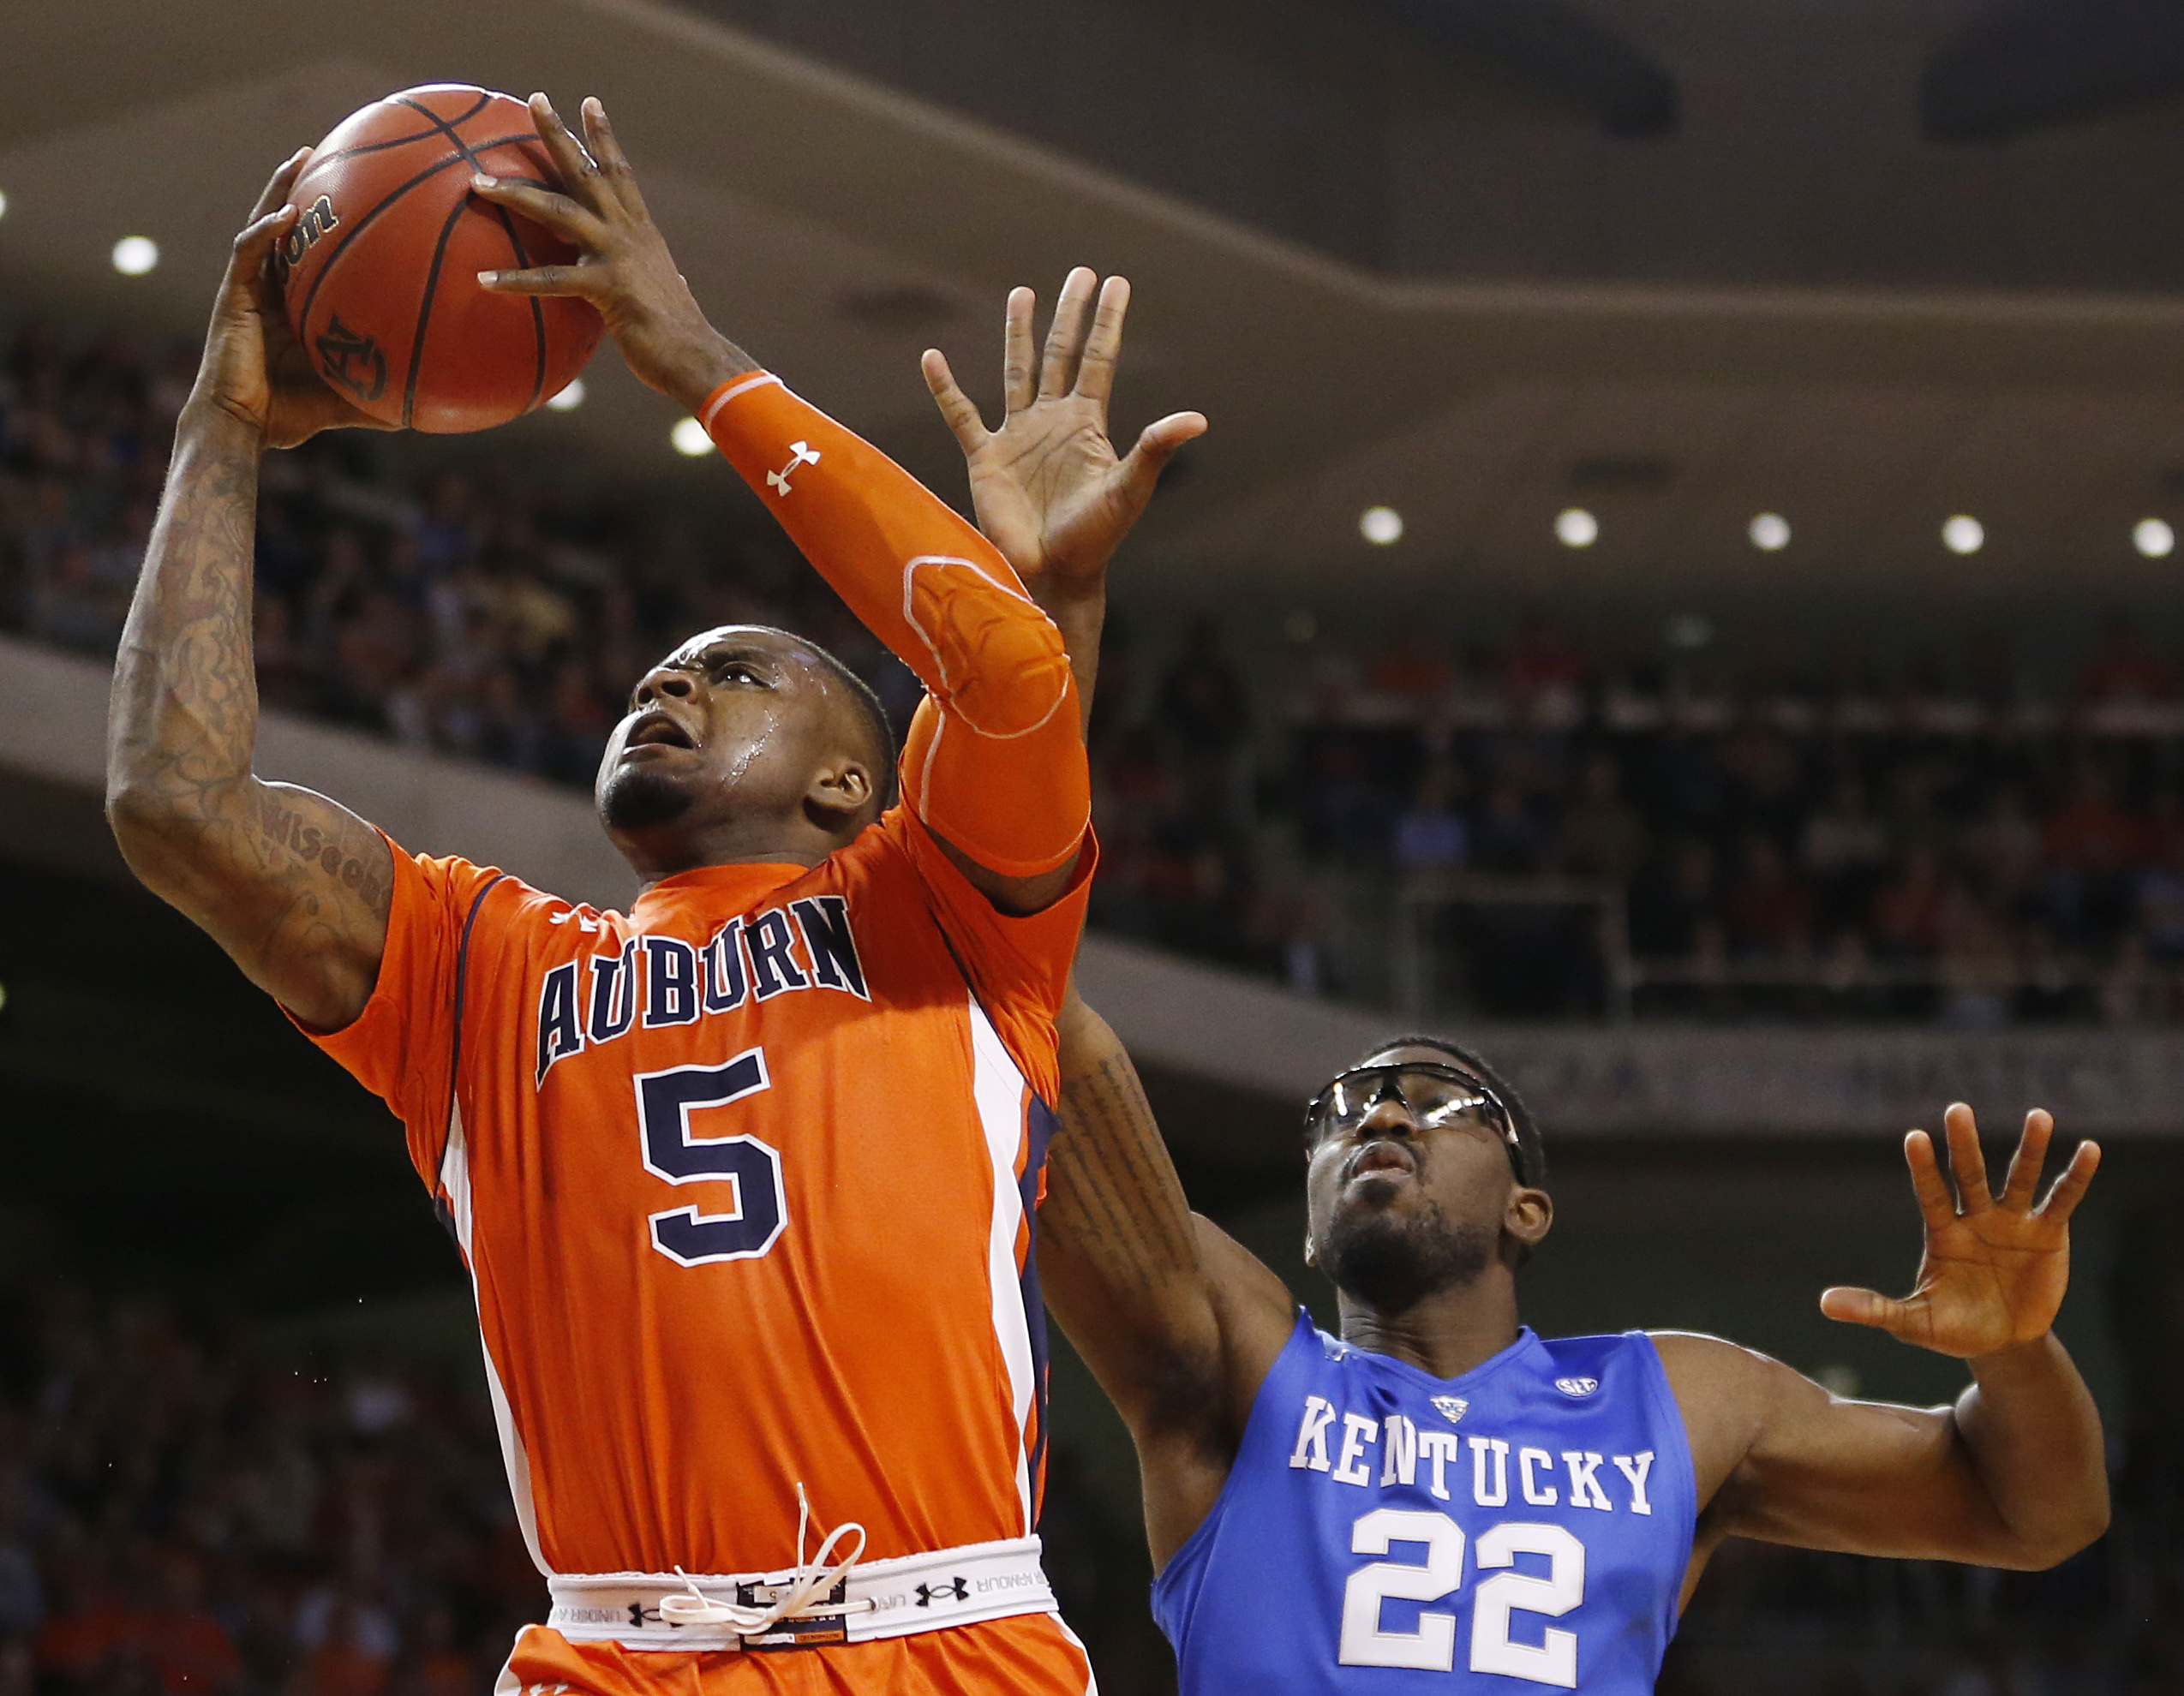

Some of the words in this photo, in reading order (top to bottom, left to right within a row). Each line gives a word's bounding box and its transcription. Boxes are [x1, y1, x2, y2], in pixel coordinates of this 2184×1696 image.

[536, 895, 872, 1092] AUBURN
[633, 1047, 789, 1268] 5
[1289, 1395, 1654, 1515] KENTUCKY
[1338, 1508, 1586, 1689] 22
